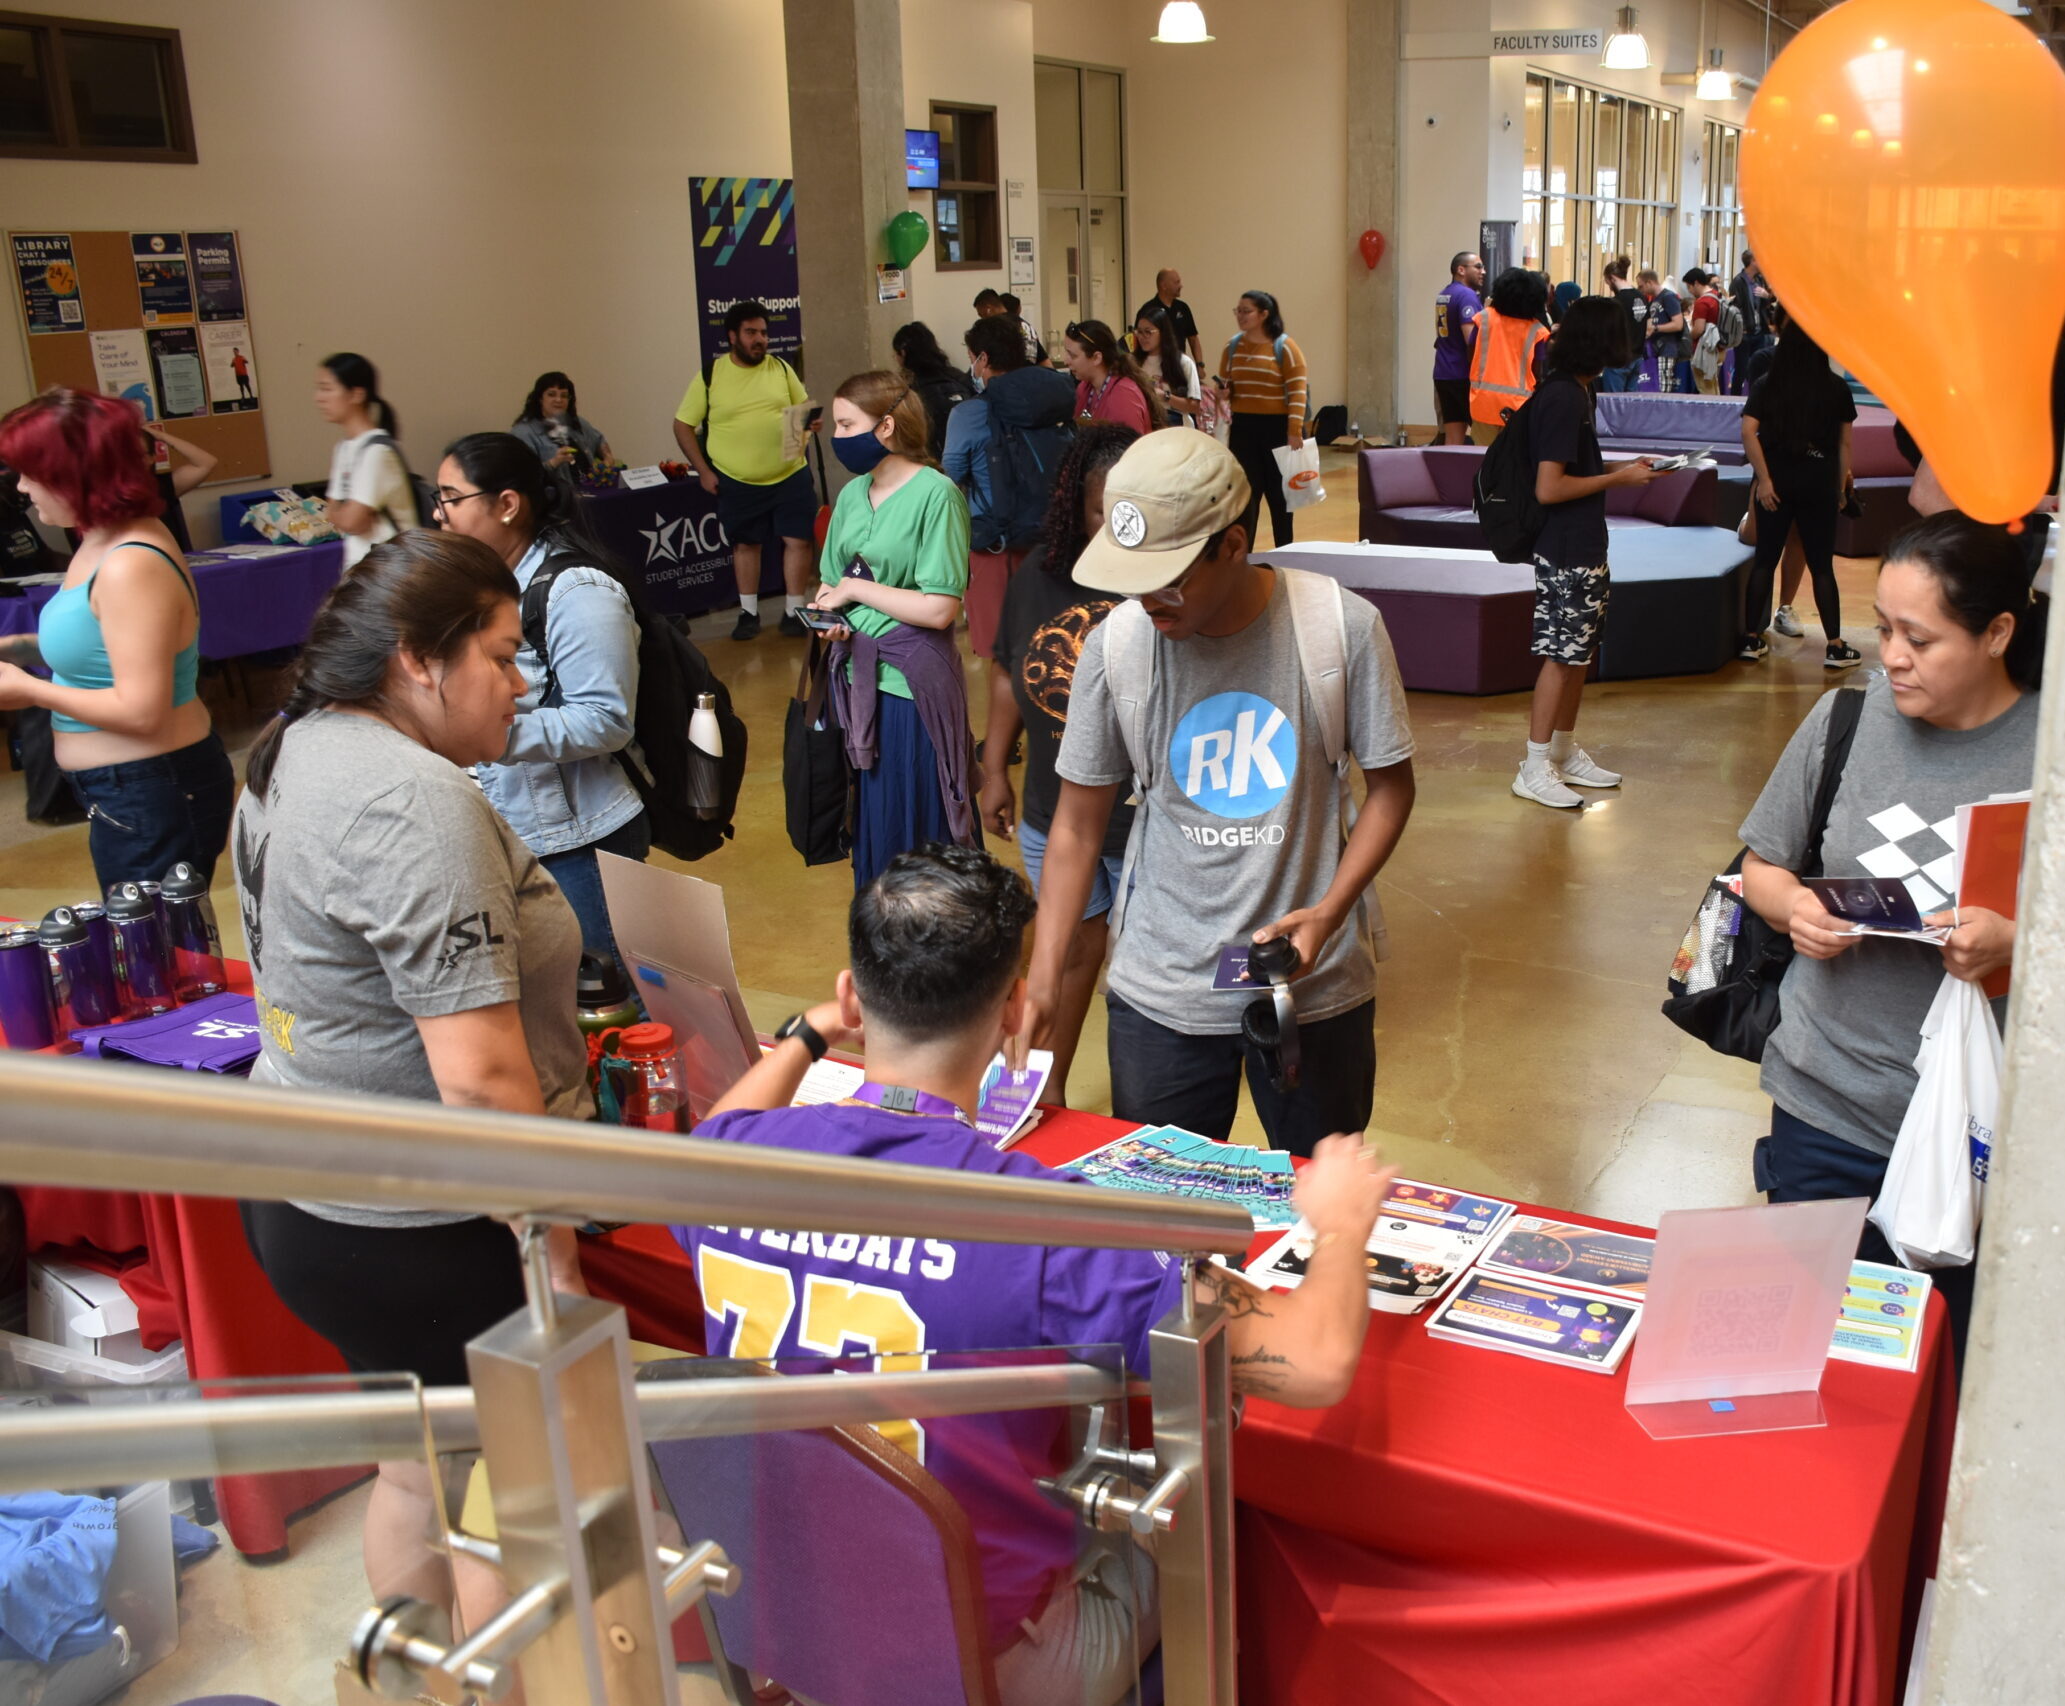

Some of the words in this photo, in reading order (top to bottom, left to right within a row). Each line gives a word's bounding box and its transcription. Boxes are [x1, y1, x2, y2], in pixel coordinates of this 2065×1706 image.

[1493, 36, 1549, 50] FACULTY
[1552, 34, 1598, 49] SUITES
[15, 241, 69, 250] LIBRARY
[196, 248, 230, 257] Parking
[198, 256, 230, 265] Permits
[49, 266, 74, 291] 24/7
[708, 297, 756, 314] Stud
[208, 329, 242, 341] CAREER
[99, 352, 119, 360] Care
[101, 360, 118, 369] Your
[120, 358, 138, 367] Mind
[645, 567, 684, 584] STUDENT
[685, 554, 735, 574] ACCESSIBILIT
[677, 572, 715, 589] SERVICES
[1186, 707, 1288, 798] RK
[445, 911, 505, 951] SL
[1462, 1302, 1510, 1321] CHATS
[1517, 1315, 1543, 1328] BAT
